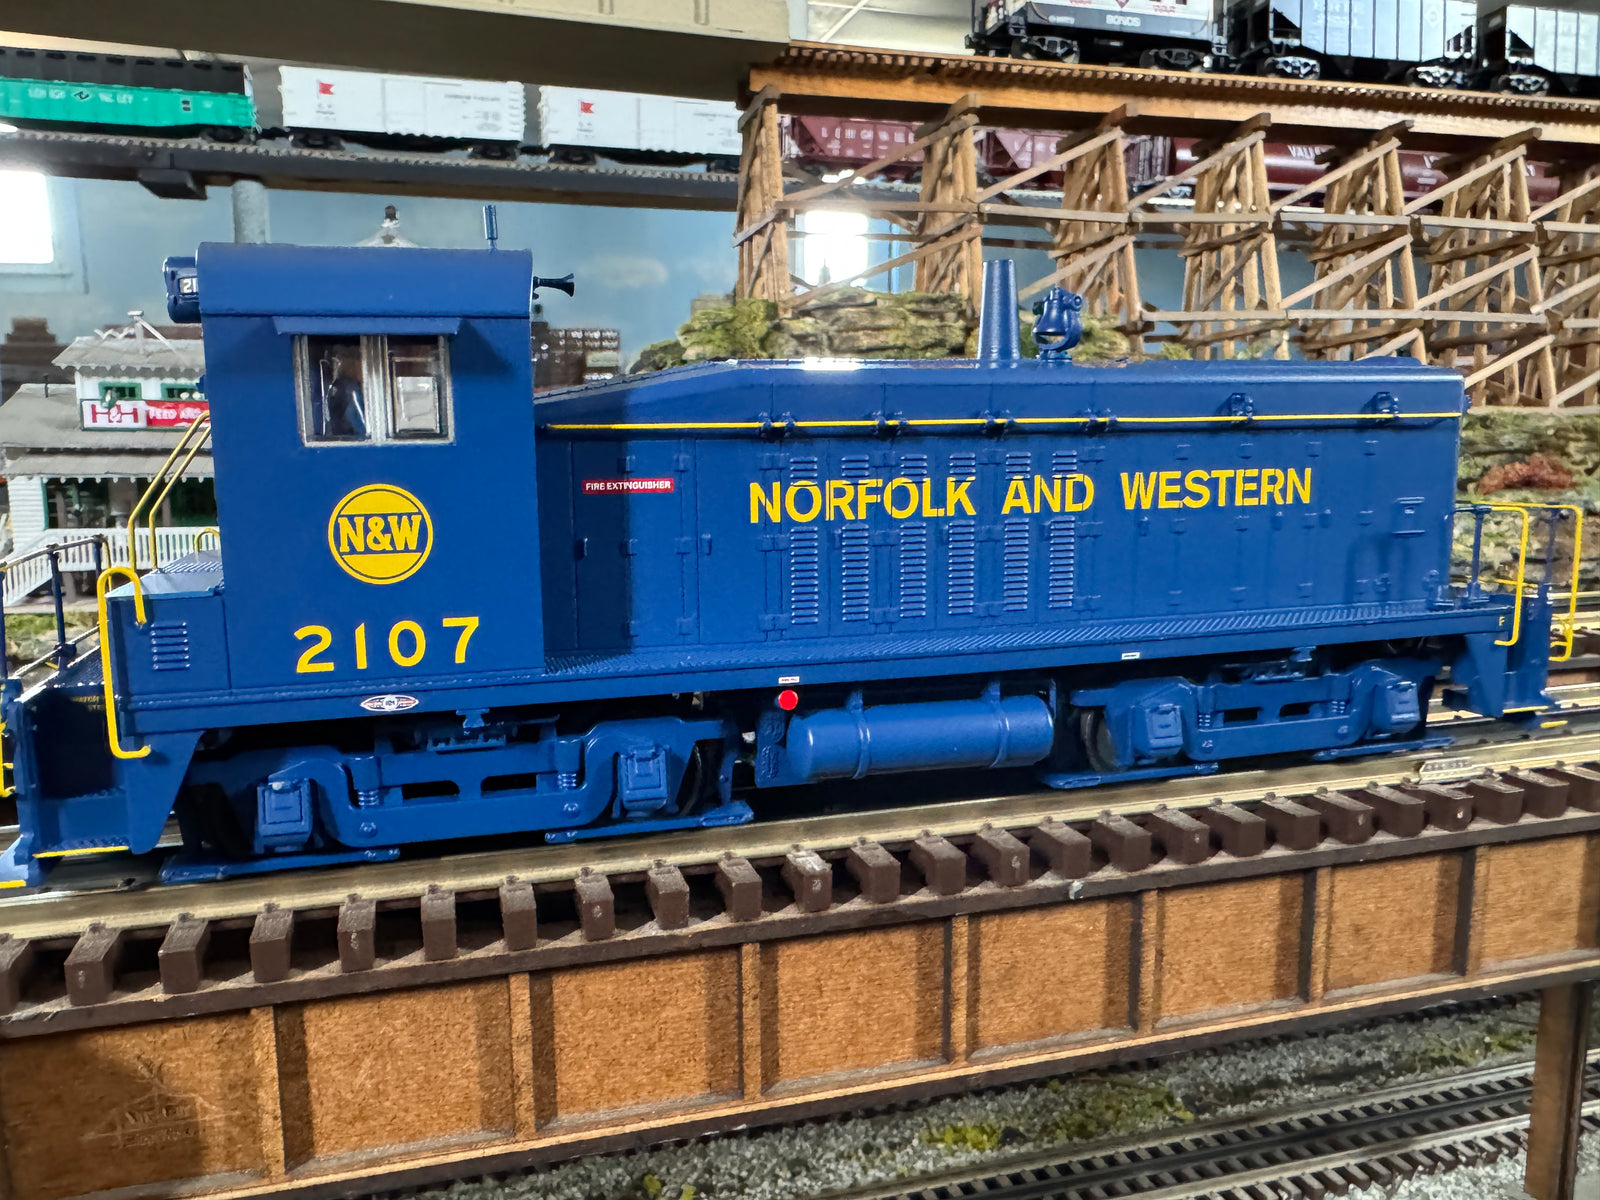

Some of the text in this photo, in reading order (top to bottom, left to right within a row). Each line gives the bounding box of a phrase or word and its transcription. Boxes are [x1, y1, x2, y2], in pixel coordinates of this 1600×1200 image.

[91, 404, 139, 423] H&H
[585, 480, 671, 491] FIRE EXTINGUISHER
[749, 467, 1312, 523] NORFOLK AND WESTERN
[338, 514, 422, 553] N&W
[1498, 615, 1506, 627] F
[293, 616, 479, 673] 2107
